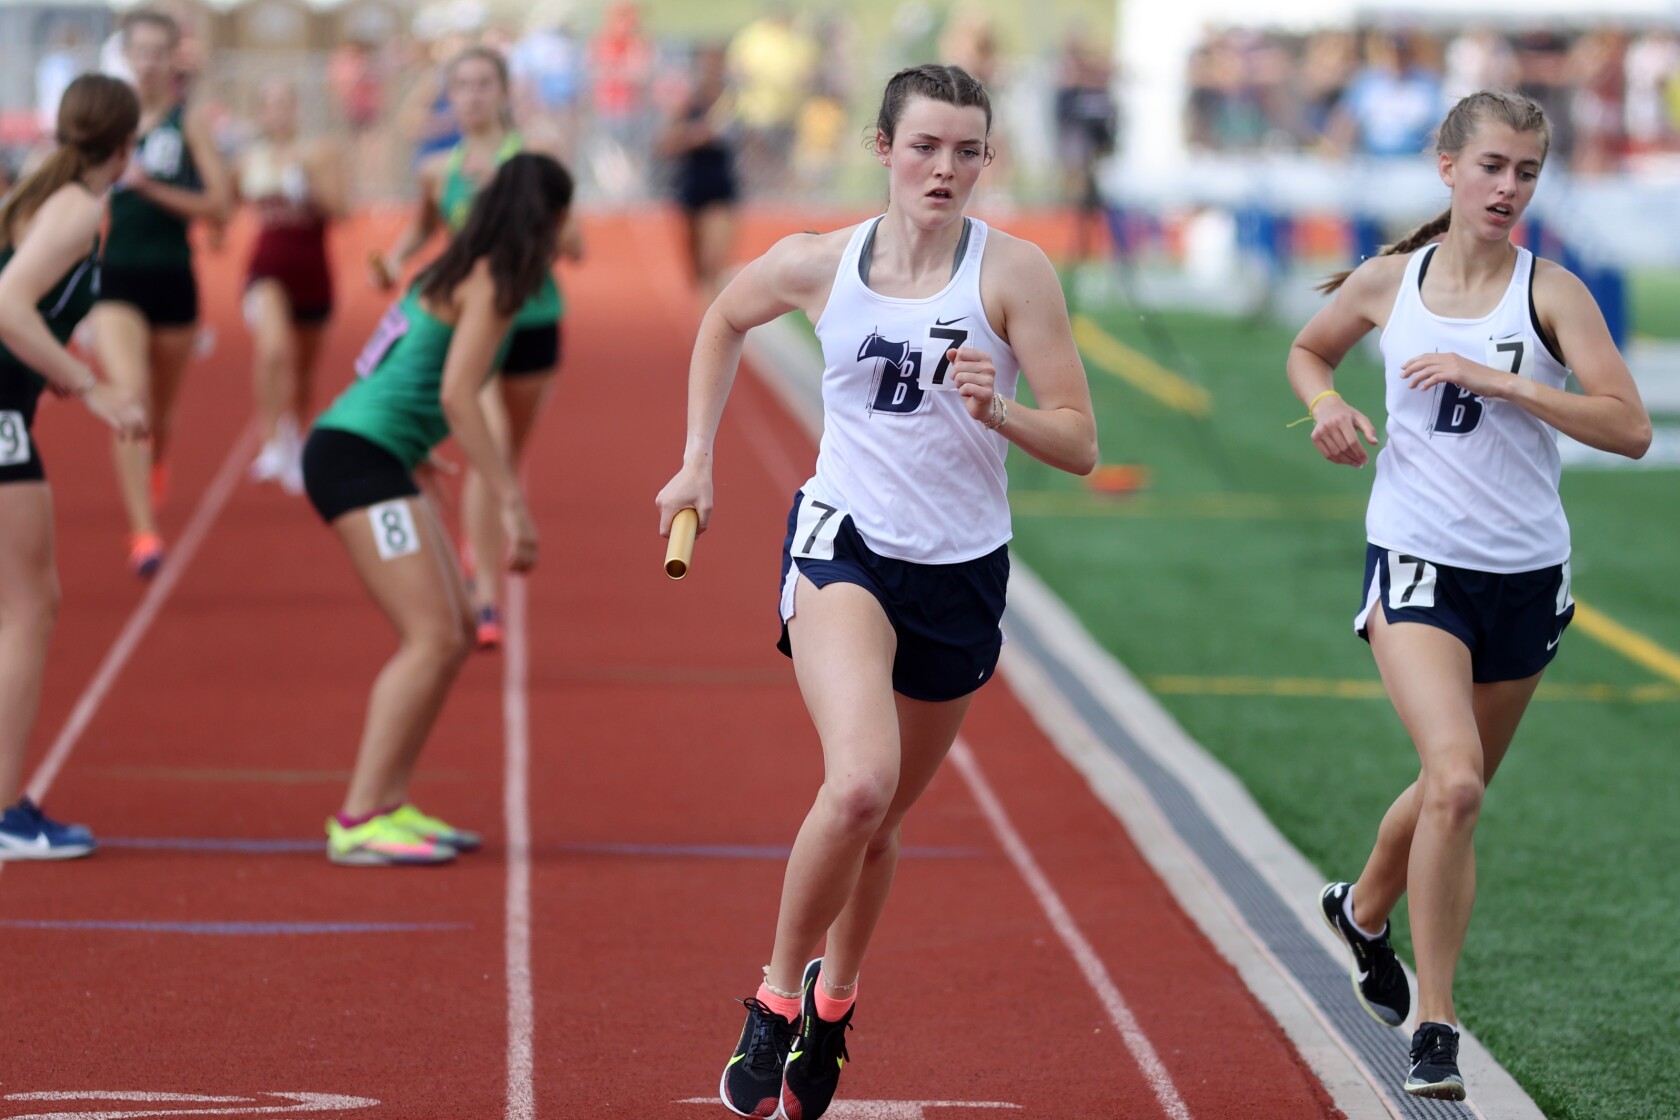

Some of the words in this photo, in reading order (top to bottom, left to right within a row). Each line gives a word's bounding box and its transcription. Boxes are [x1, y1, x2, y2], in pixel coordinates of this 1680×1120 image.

[930, 327, 968, 385] 7
[1496, 341, 1524, 375] 7
[0, 416, 20, 458] 9
[381, 509, 409, 550] 8
[802, 500, 838, 554] 7
[1398, 554, 1427, 604] 7
